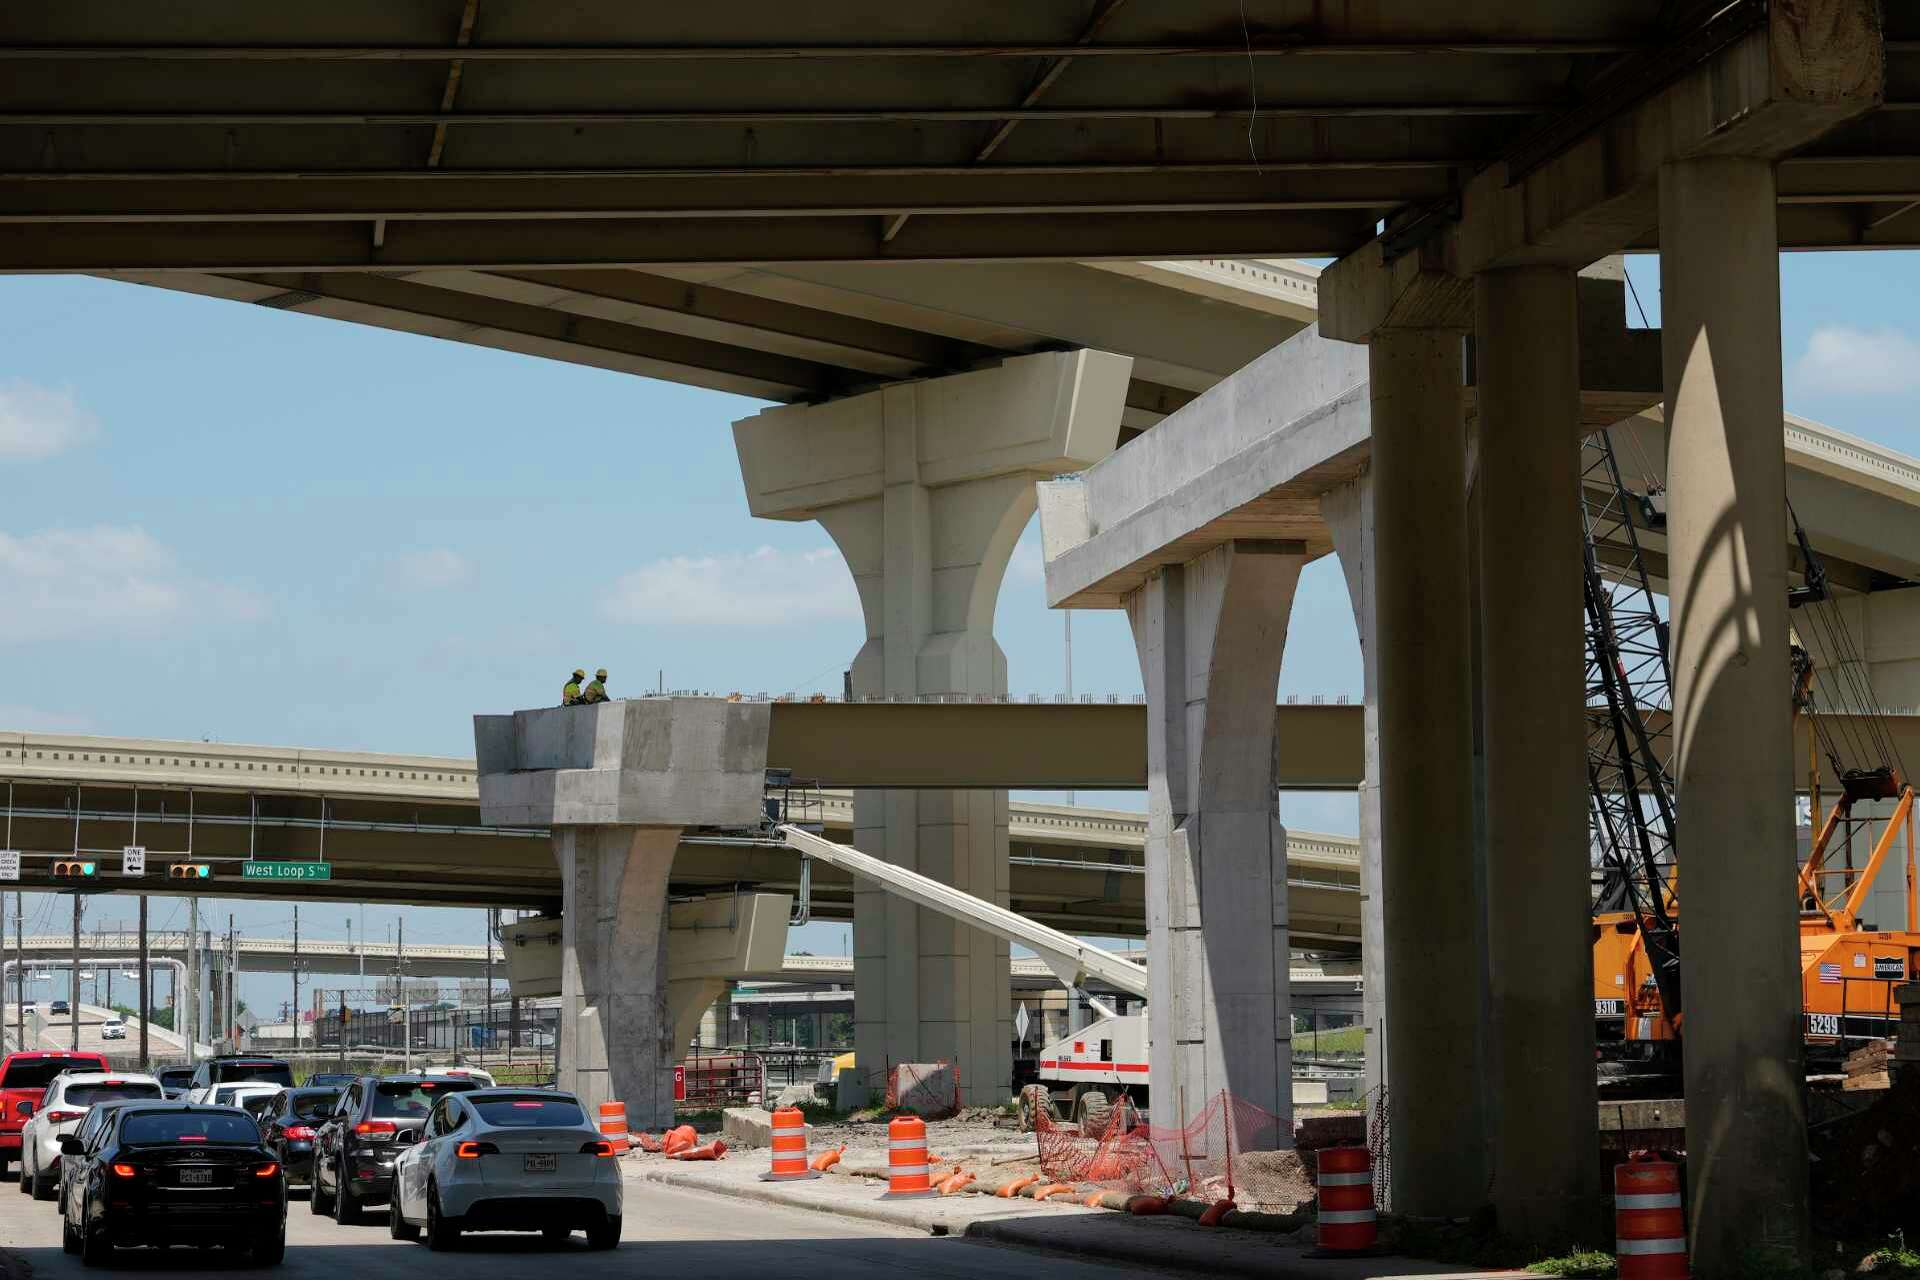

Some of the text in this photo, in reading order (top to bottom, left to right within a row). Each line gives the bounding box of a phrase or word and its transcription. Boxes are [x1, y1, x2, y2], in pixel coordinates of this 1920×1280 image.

[246, 865, 273, 876] West
[278, 866, 304, 879] Loop
[308, 866, 315, 877] S
[1874, 963, 1904, 972] AMERICAN
[1595, 1001, 1617, 1014] 9310
[1810, 1015, 1838, 1035] 5299
